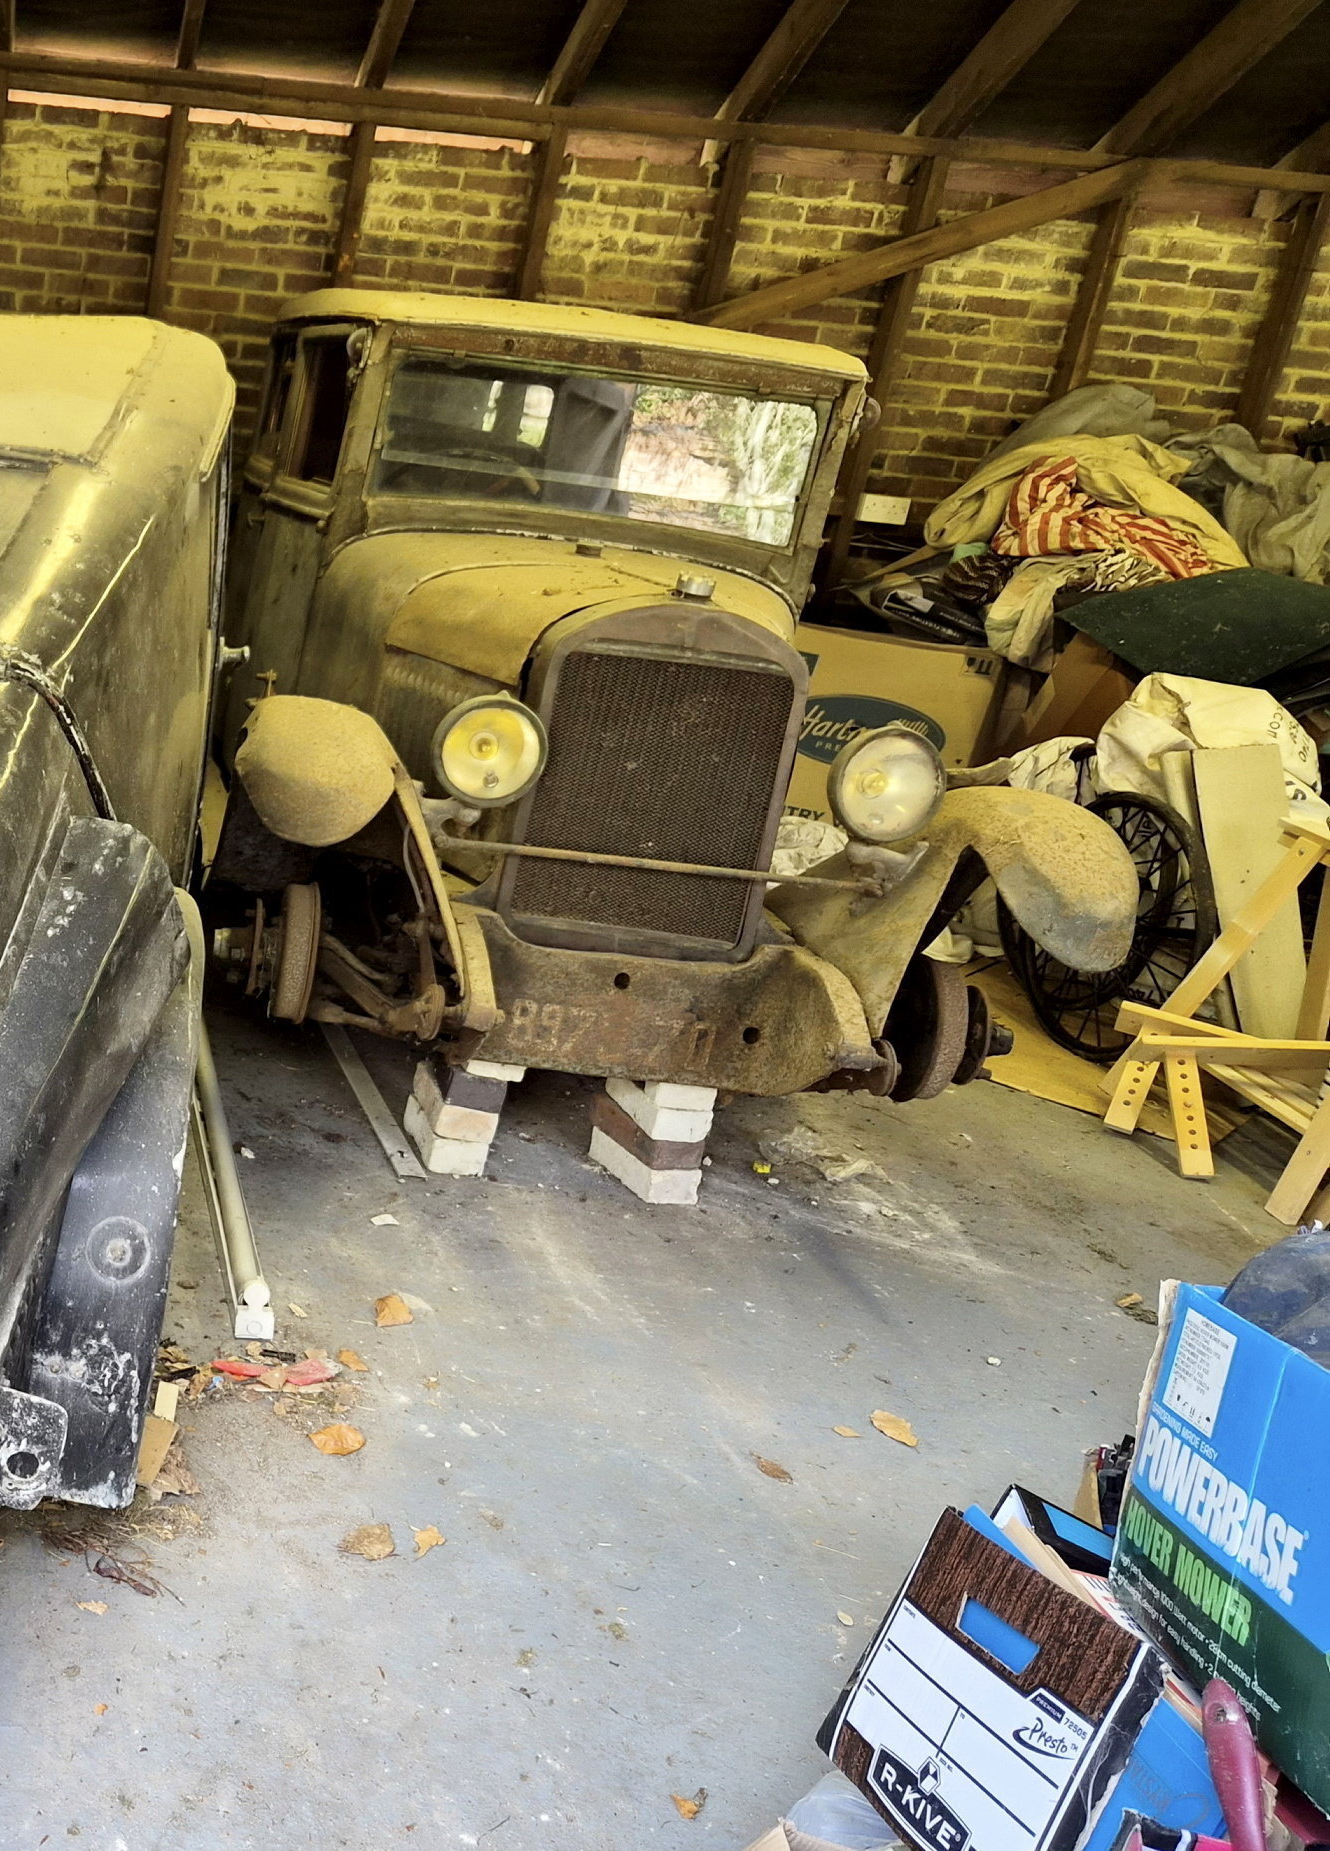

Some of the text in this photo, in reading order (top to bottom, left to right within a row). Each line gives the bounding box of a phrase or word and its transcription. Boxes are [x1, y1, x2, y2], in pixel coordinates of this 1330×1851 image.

[1181, 1426, 1201, 1448] MADE
[1199, 1441, 1218, 1462] EASY
[1137, 1416, 1306, 1606] POWERBASE
[1123, 1496, 1252, 1647] HOVER MOWER
[1158, 1613, 1167, 1628] for
[1167, 1625, 1181, 1646] easy
[1180, 1635, 1204, 1669] handling
[1186, 1621, 1205, 1642] motor
[1227, 1659, 1251, 1688] cutting
[1251, 1680, 1282, 1713] diameter
[1028, 1716, 1068, 1754] Presto
[1035, 1695, 1087, 1740] PREMIUM 72505
[880, 1762, 957, 1851] R-KIVE
